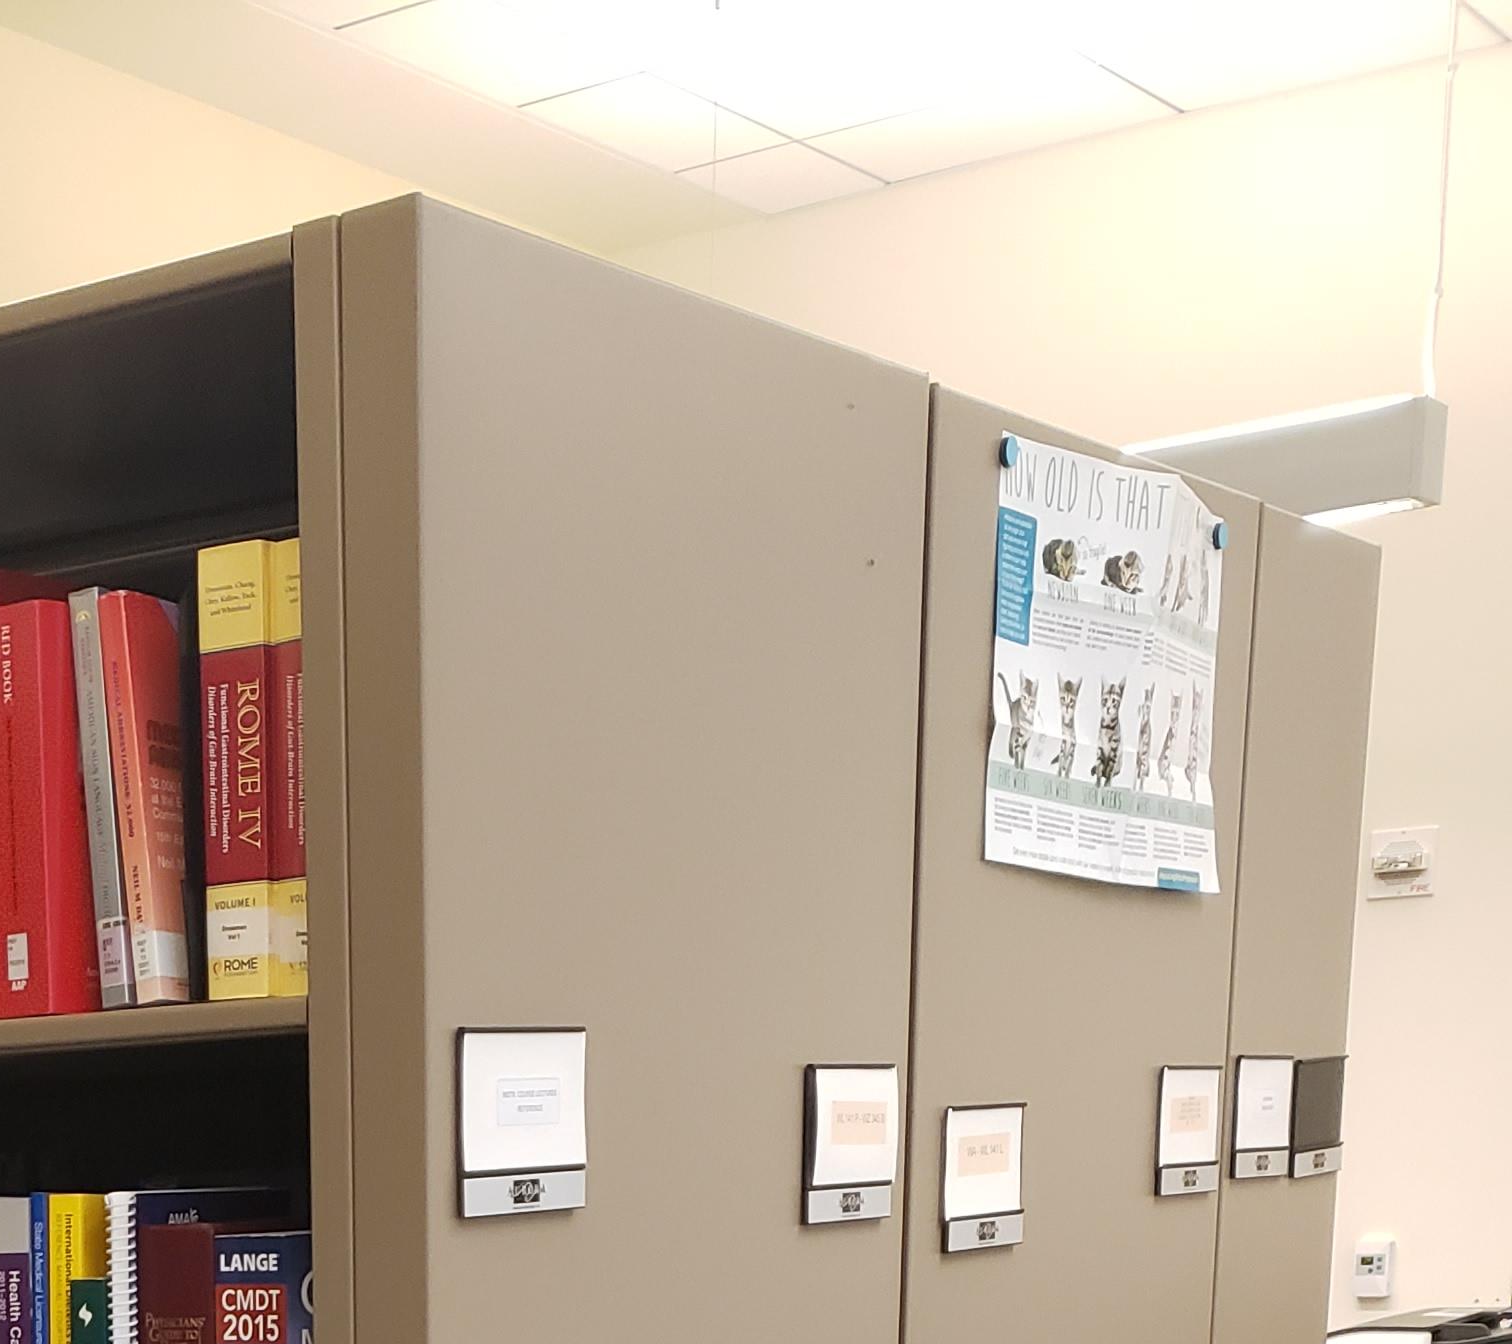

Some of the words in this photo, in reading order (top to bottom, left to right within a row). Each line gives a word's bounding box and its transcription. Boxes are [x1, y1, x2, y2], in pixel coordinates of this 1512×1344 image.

[1045, 457, 1078, 513] OLD
[1088, 469, 1105, 521] IS
[1115, 475, 1171, 530] THAT
[1, 625, 11, 656] RED
[2, 661, 13, 705] BOOK
[207, 686, 216, 728] Disorders
[219, 684, 230, 734] Functional
[237, 679, 262, 796] ROME
[208, 741, 218, 786] Gut-Brain
[220, 735, 231, 808] Gastrointestinal
[210, 788, 218, 836] Interaction
[222, 809, 232, 853] Disorders
[239, 808, 262, 849] IV
[215, 898, 248, 910] VOLUME
[224, 958, 258, 971] ROME
[34, 1222, 43, 1249] State
[168, 1213, 190, 1225] AMA
[34, 1252, 44, 1292] Medical
[220, 1254, 279, 1271] LANGE
[8, 1270, 22, 1322] Health
[222, 1289, 280, 1311] CMDT
[223, 1314, 279, 1341] 2015
